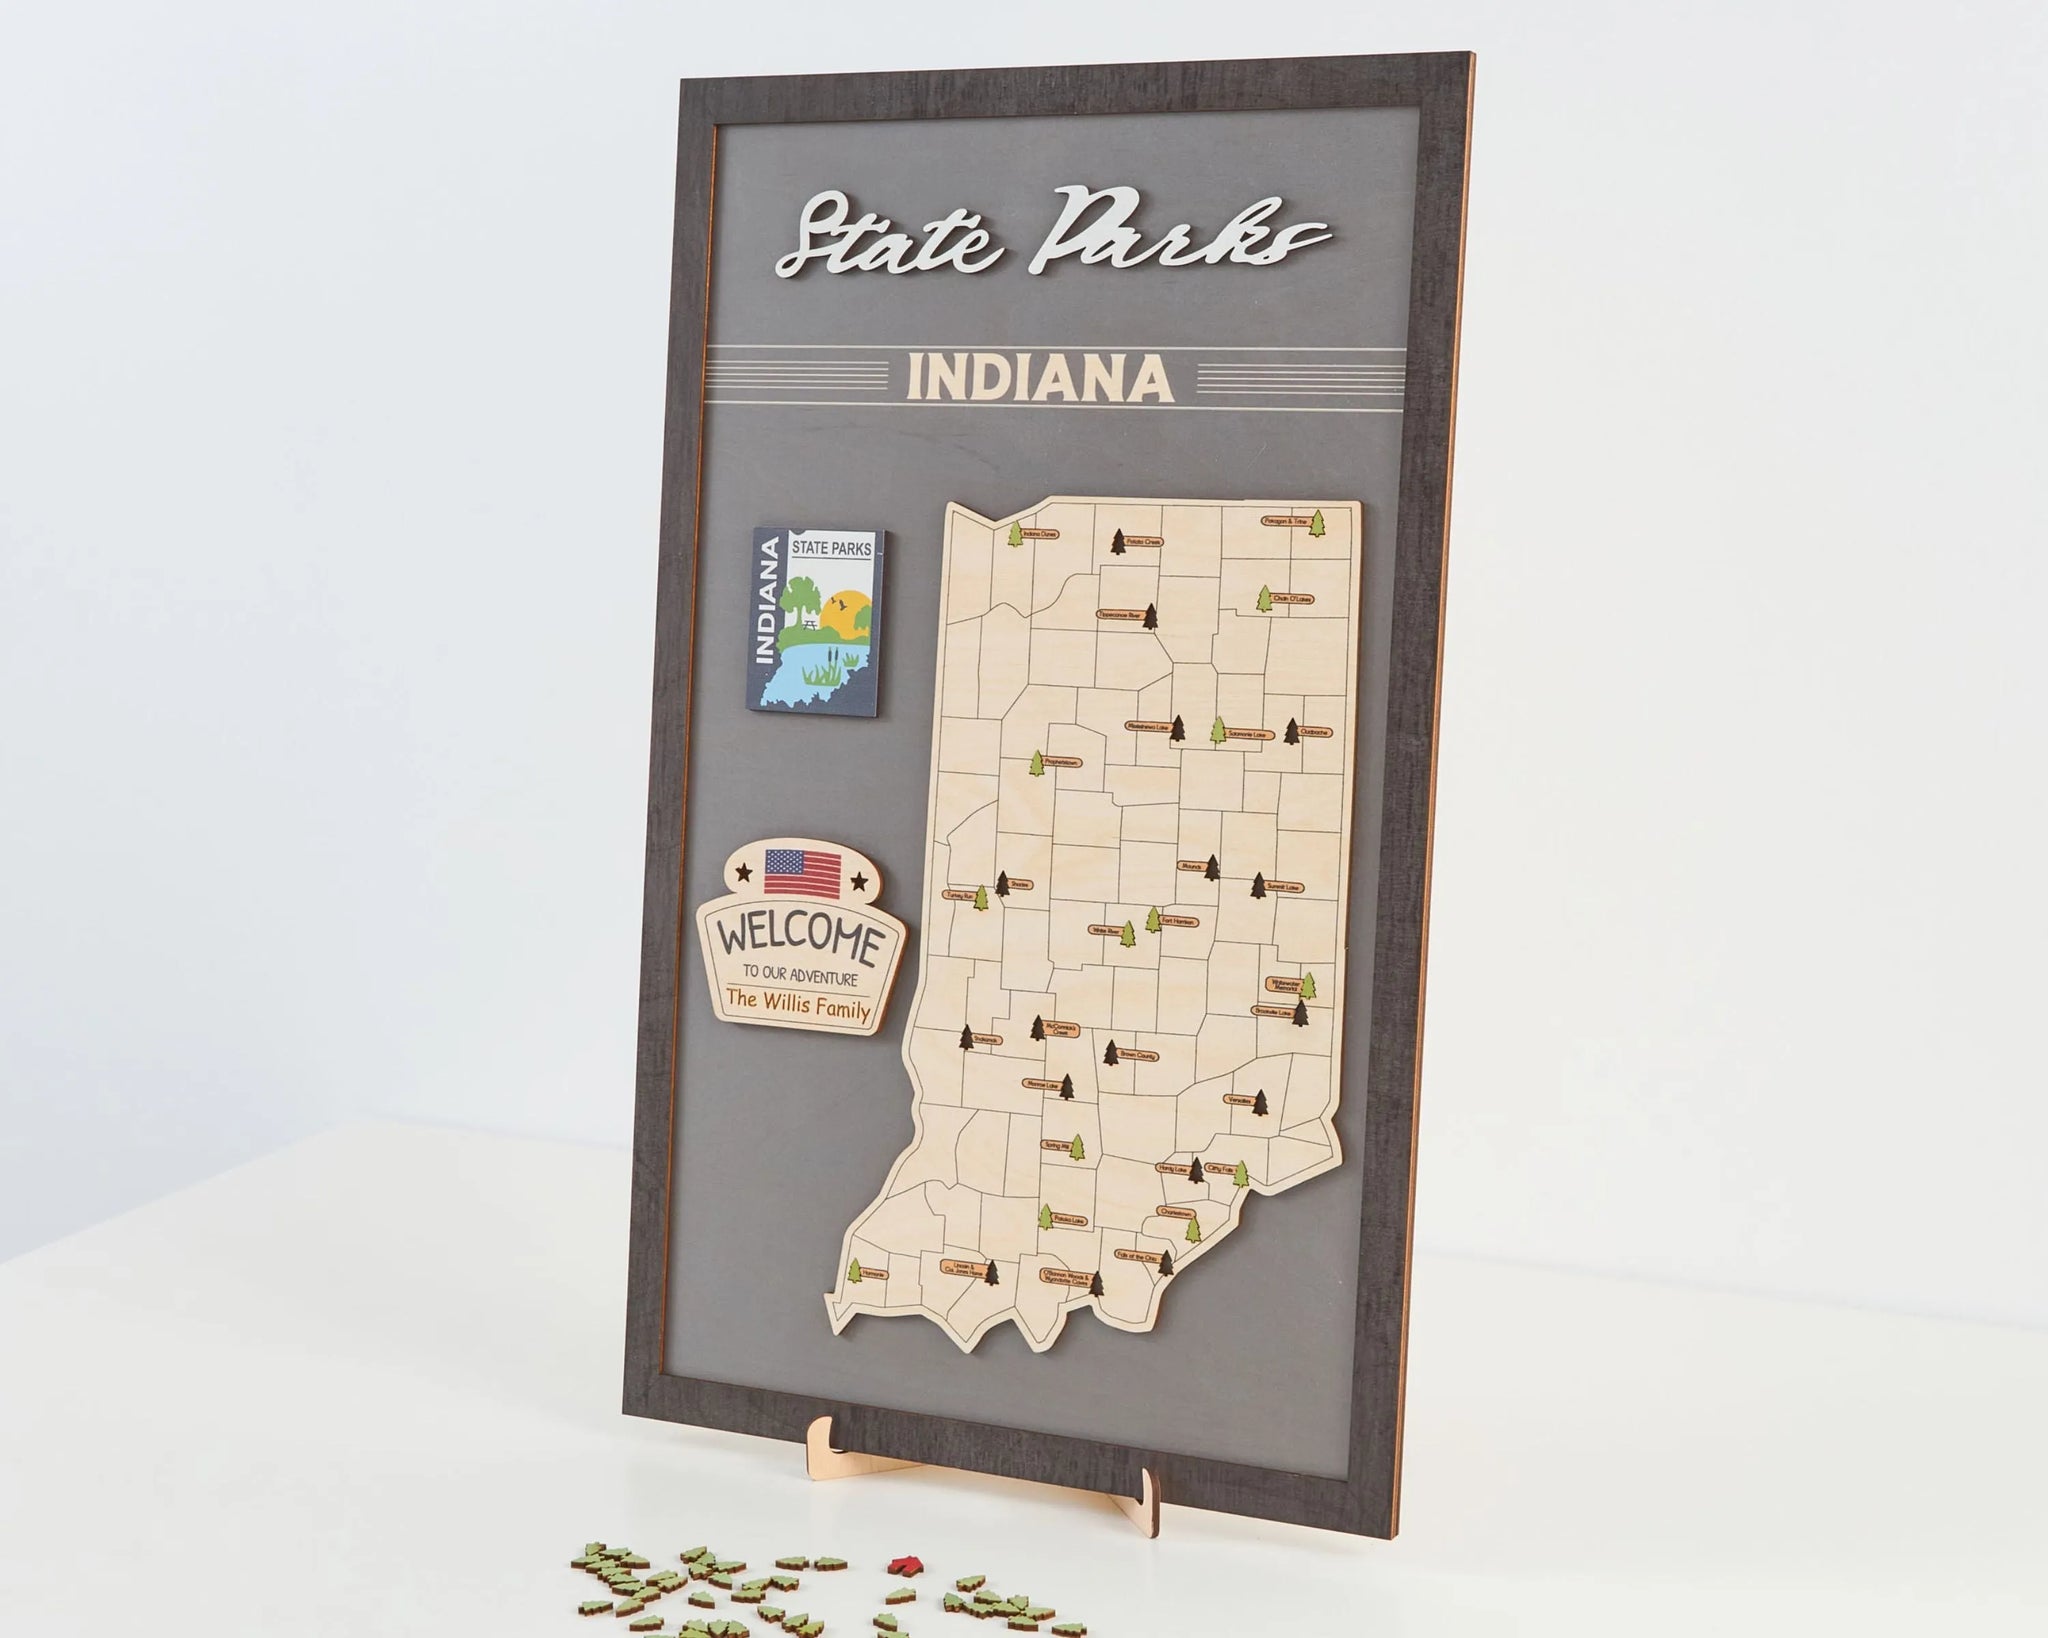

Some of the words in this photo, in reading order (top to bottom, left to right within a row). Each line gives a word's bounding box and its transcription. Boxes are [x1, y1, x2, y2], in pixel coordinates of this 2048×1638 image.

[775, 190, 1004, 278] State
[1028, 185, 1333, 275] Parks
[907, 352, 1175, 403] INDIANA
[792, 540, 828, 554] STATE
[832, 541, 872, 556] PARKS
[756, 536, 779, 664] INDIANA
[717, 909, 886, 968] WELCOME
[743, 964, 759, 978] TO
[763, 966, 787, 980] OUR
[790, 970, 858, 987] ADVENTURE
[726, 988, 758, 1007] The
[764, 992, 810, 1013] Willis
[816, 998, 871, 1024] Family
